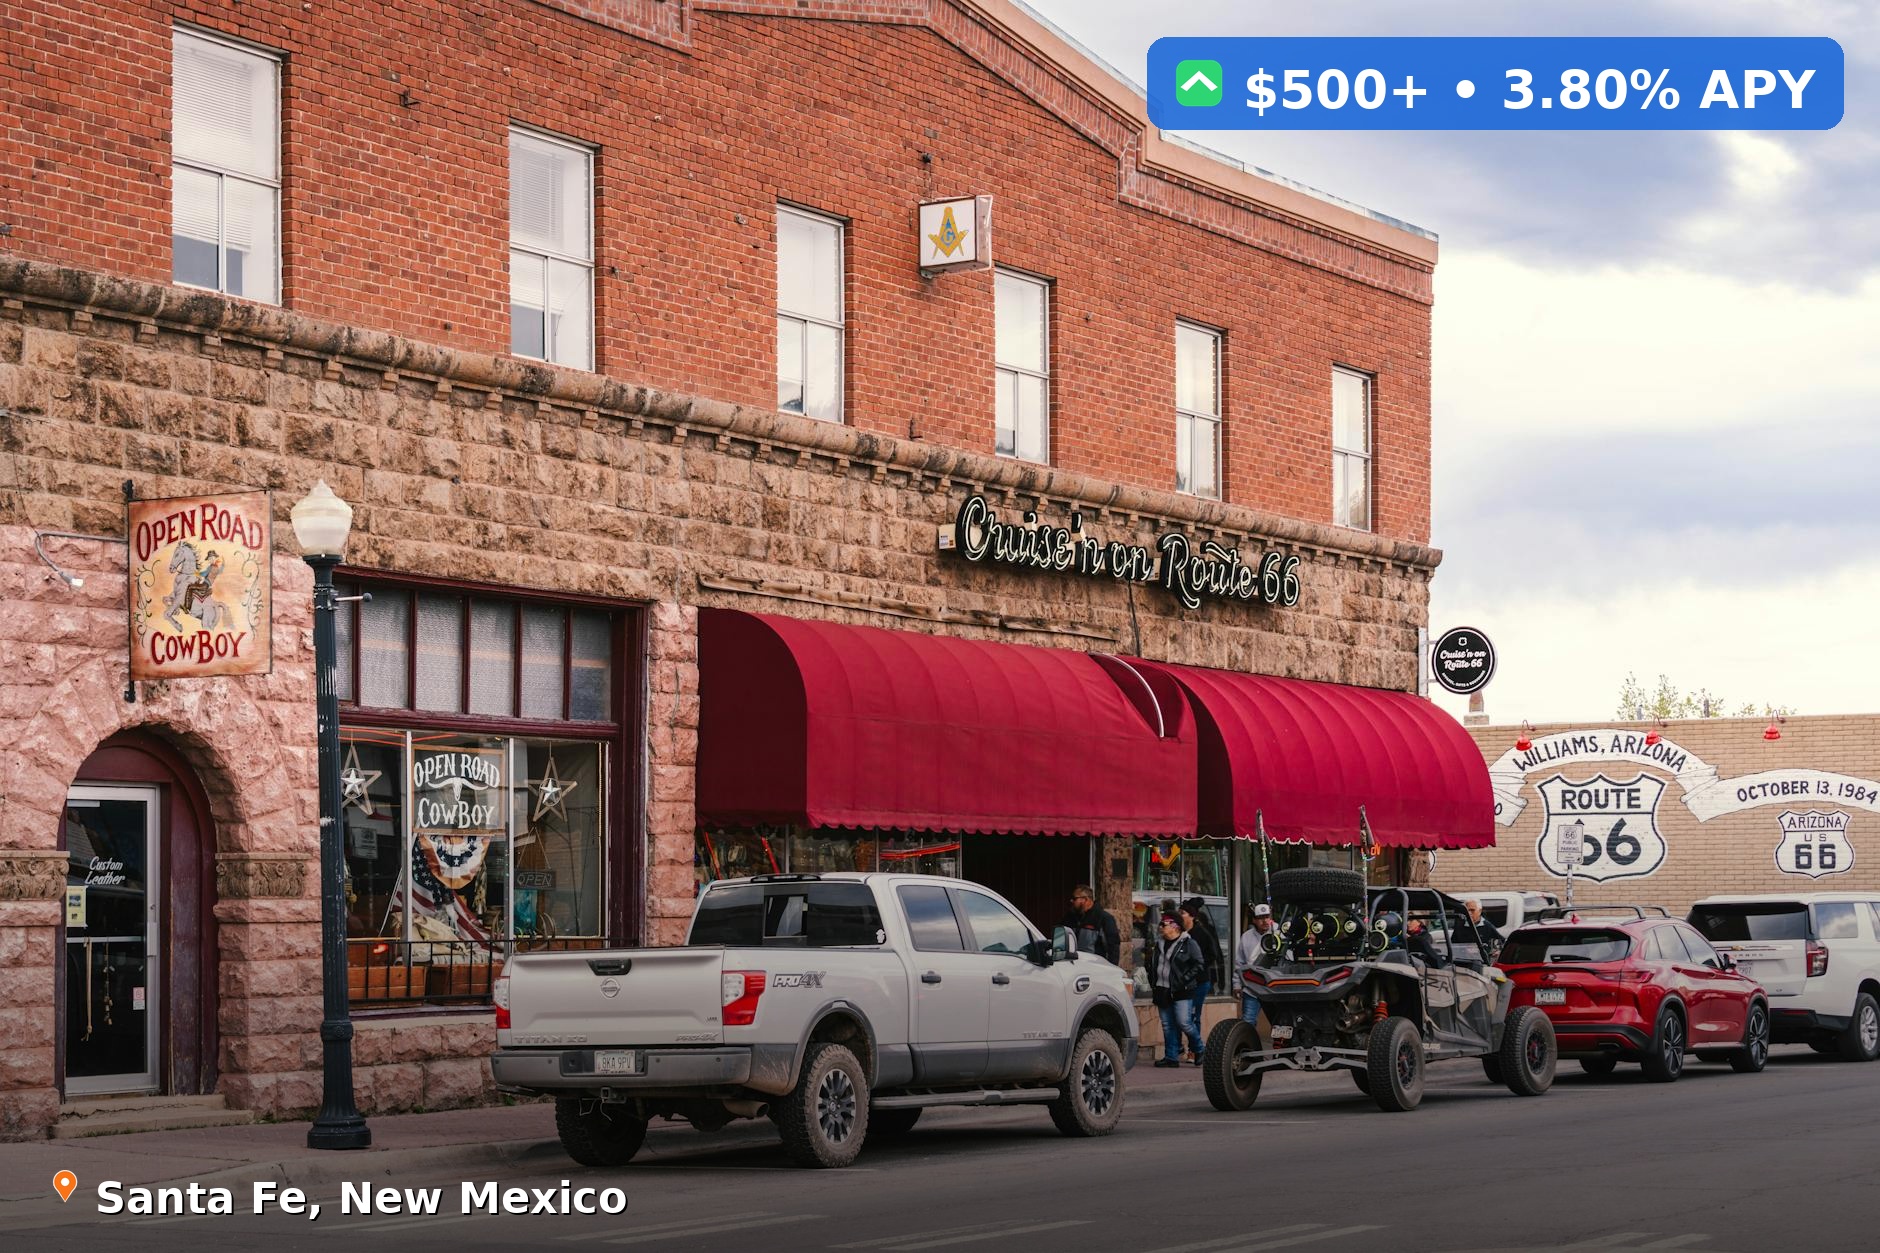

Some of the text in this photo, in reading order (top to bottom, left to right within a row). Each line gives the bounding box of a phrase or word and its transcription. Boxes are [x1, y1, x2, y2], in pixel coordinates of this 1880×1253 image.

[137, 503, 264, 562] OPEN ROAD
[955, 494, 1301, 609] Cruise'n on Route 66
[1443, 658, 1483, 671] Route 66
[1512, 734, 1687, 773] WILLIAMS, ARIZONA
[413, 753, 500, 789] OPEN ROAD
[1561, 788, 1641, 810] ROUTE
[1737, 780, 1810, 802] OCTOBER
[1838, 783, 1878, 805] 1984
[1787, 816, 1842, 829] ARIZONA
[89, 855, 123, 872] Custom
[1795, 844, 1836, 869] 66
[85, 871, 126, 886] Leather
[517, 872, 553, 887] OPEN
[514, 1033, 588, 1044] TITAN XD
